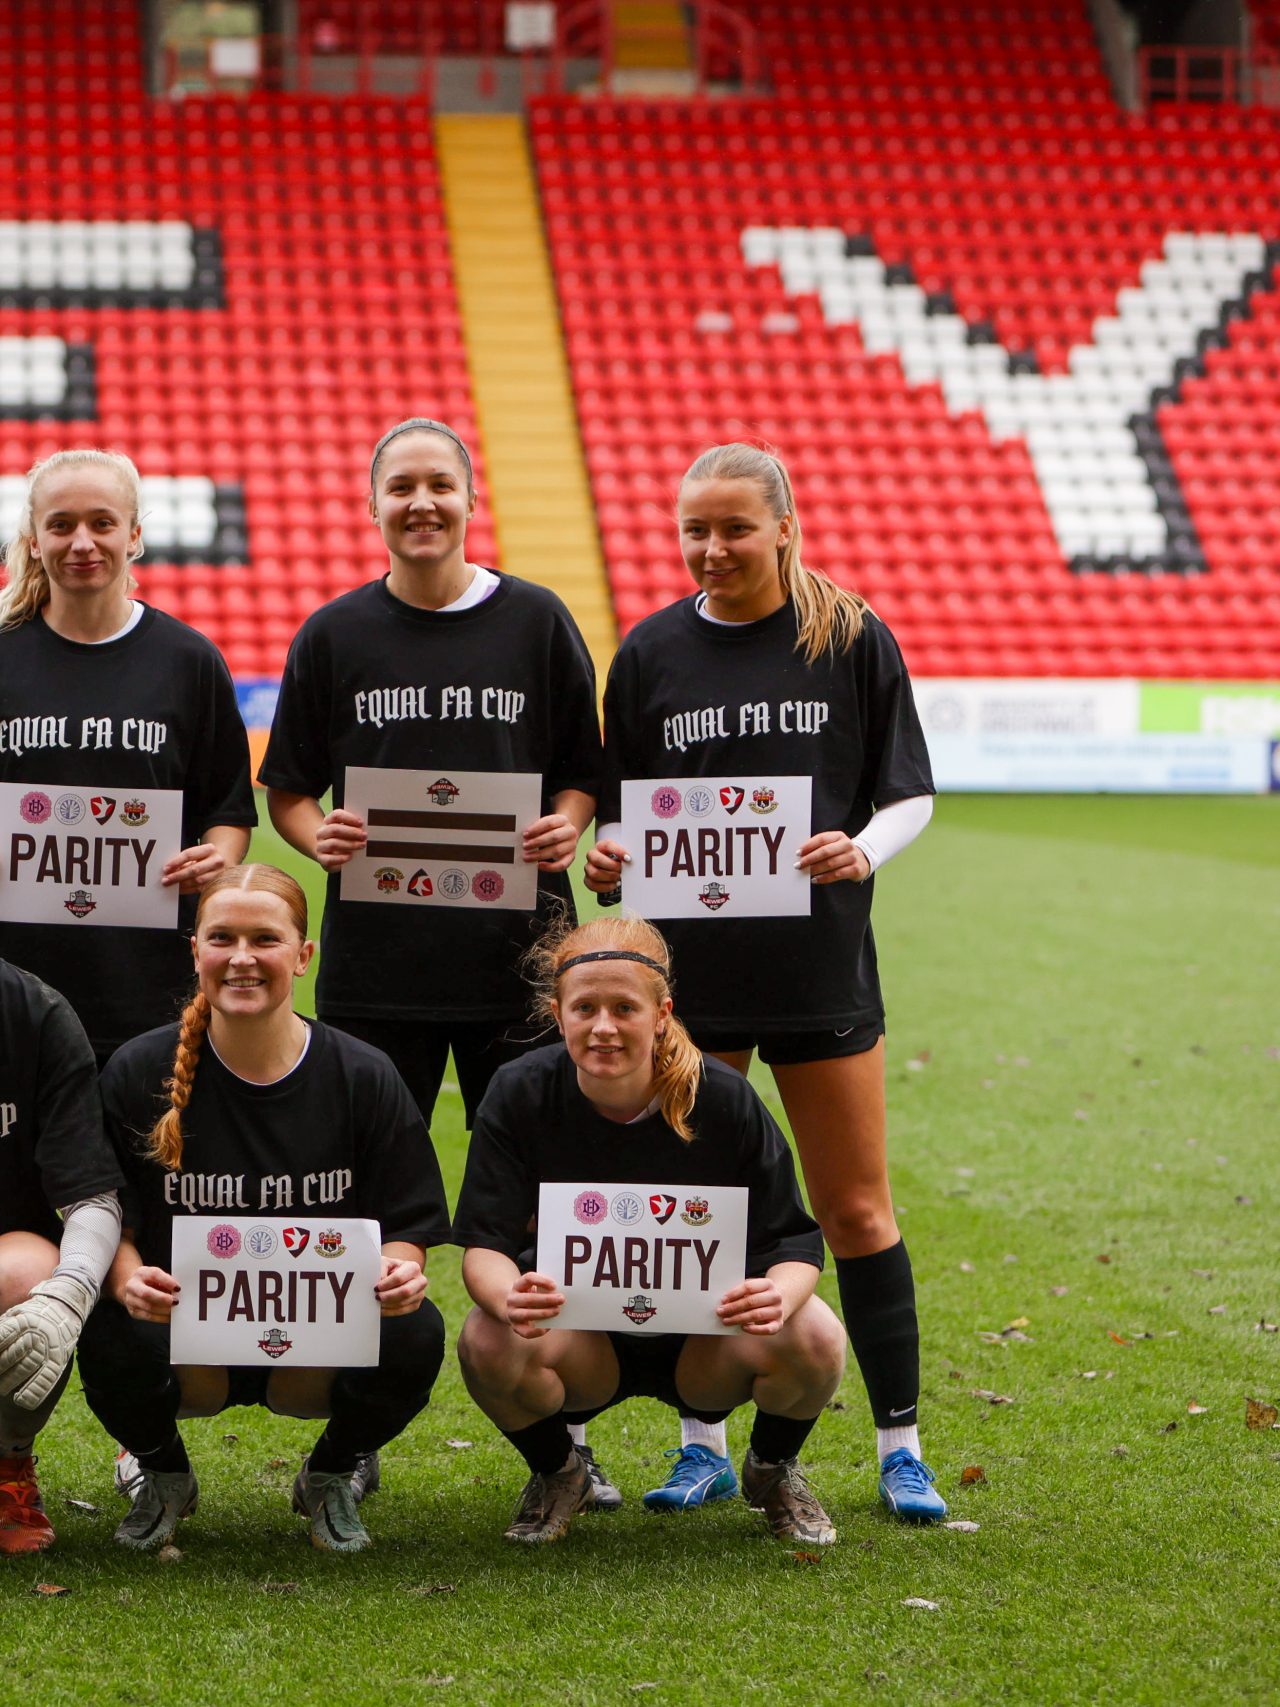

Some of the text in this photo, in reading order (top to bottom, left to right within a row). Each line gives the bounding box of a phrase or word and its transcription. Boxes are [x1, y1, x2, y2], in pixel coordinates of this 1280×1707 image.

[354, 686, 526, 729] EQUAL FA CUP
[663, 700, 829, 753] EQUAL FA CUP
[79, 716, 113, 750] FA
[121, 718, 167, 754] CUP
[9, 833, 157, 887] PARITY
[645, 826, 787, 878] PARITY
[163, 1168, 352, 1214] EQUAL FA CUP
[564, 1235, 720, 1291] PARITY
[198, 1269, 355, 1324] PARITY
